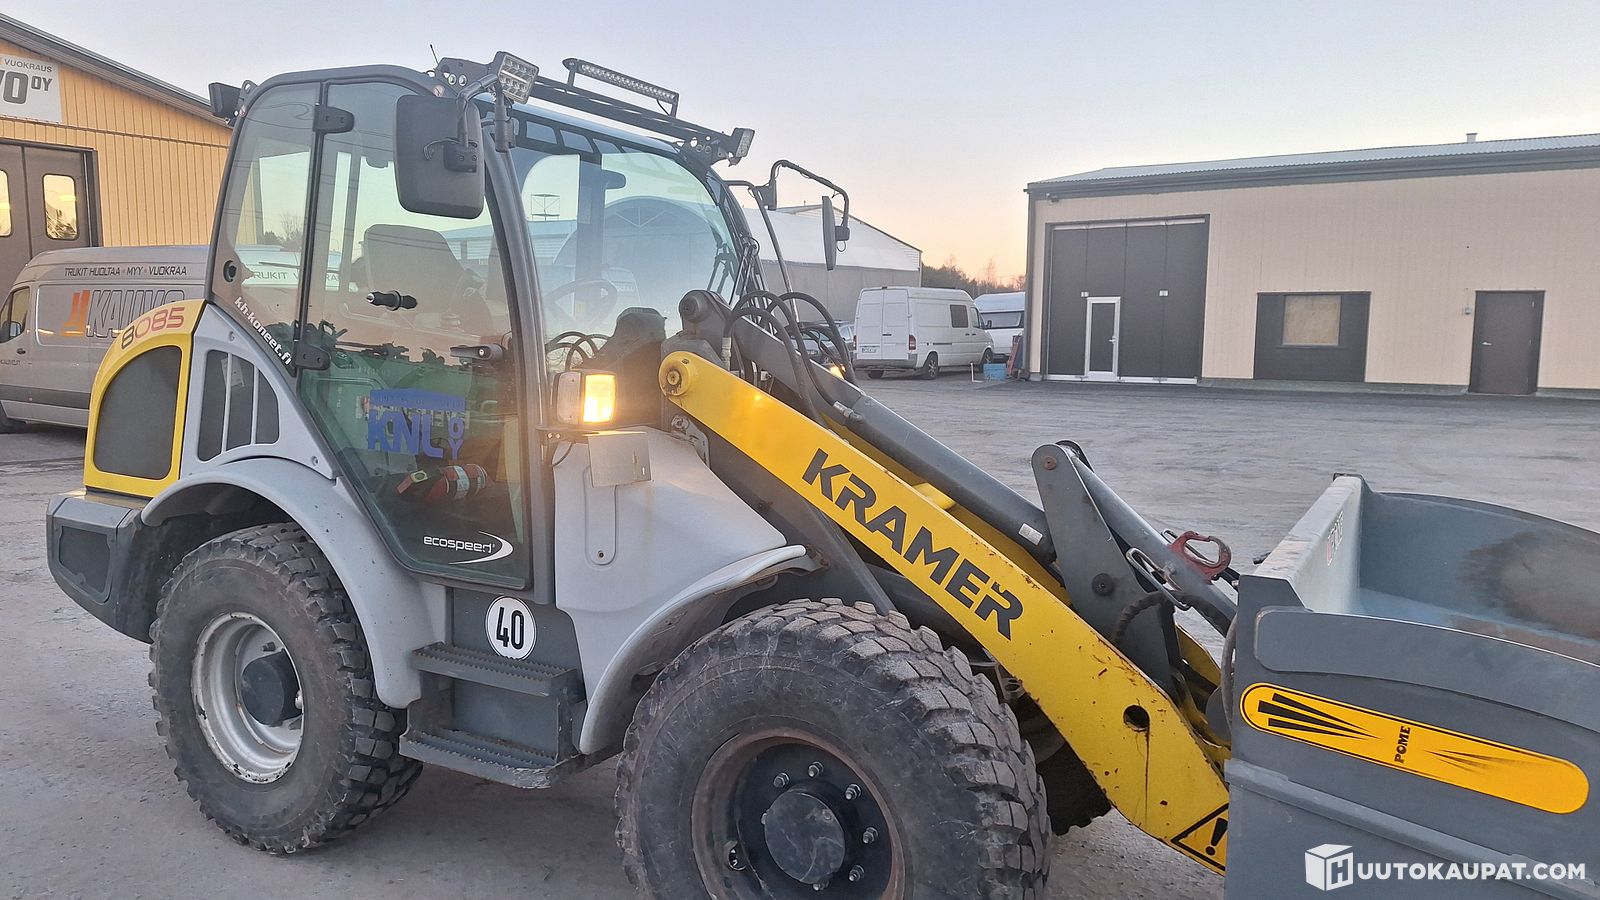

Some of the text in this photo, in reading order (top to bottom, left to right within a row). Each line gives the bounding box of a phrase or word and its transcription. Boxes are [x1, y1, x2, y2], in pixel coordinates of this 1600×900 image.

[4, 58, 53, 73] VUOKRAUS
[31, 75, 53, 92] OY
[64, 266, 187, 277] TRUKIT HUOLTAA MYY VUOKRAA
[252, 270, 289, 280] RUKIT
[121, 306, 185, 350] 8085
[234, 296, 293, 366] kh-koneet.fi
[802, 447, 1024, 641] KRAMER
[496, 606, 525, 650] 40
[1394, 725, 1411, 764] POME
